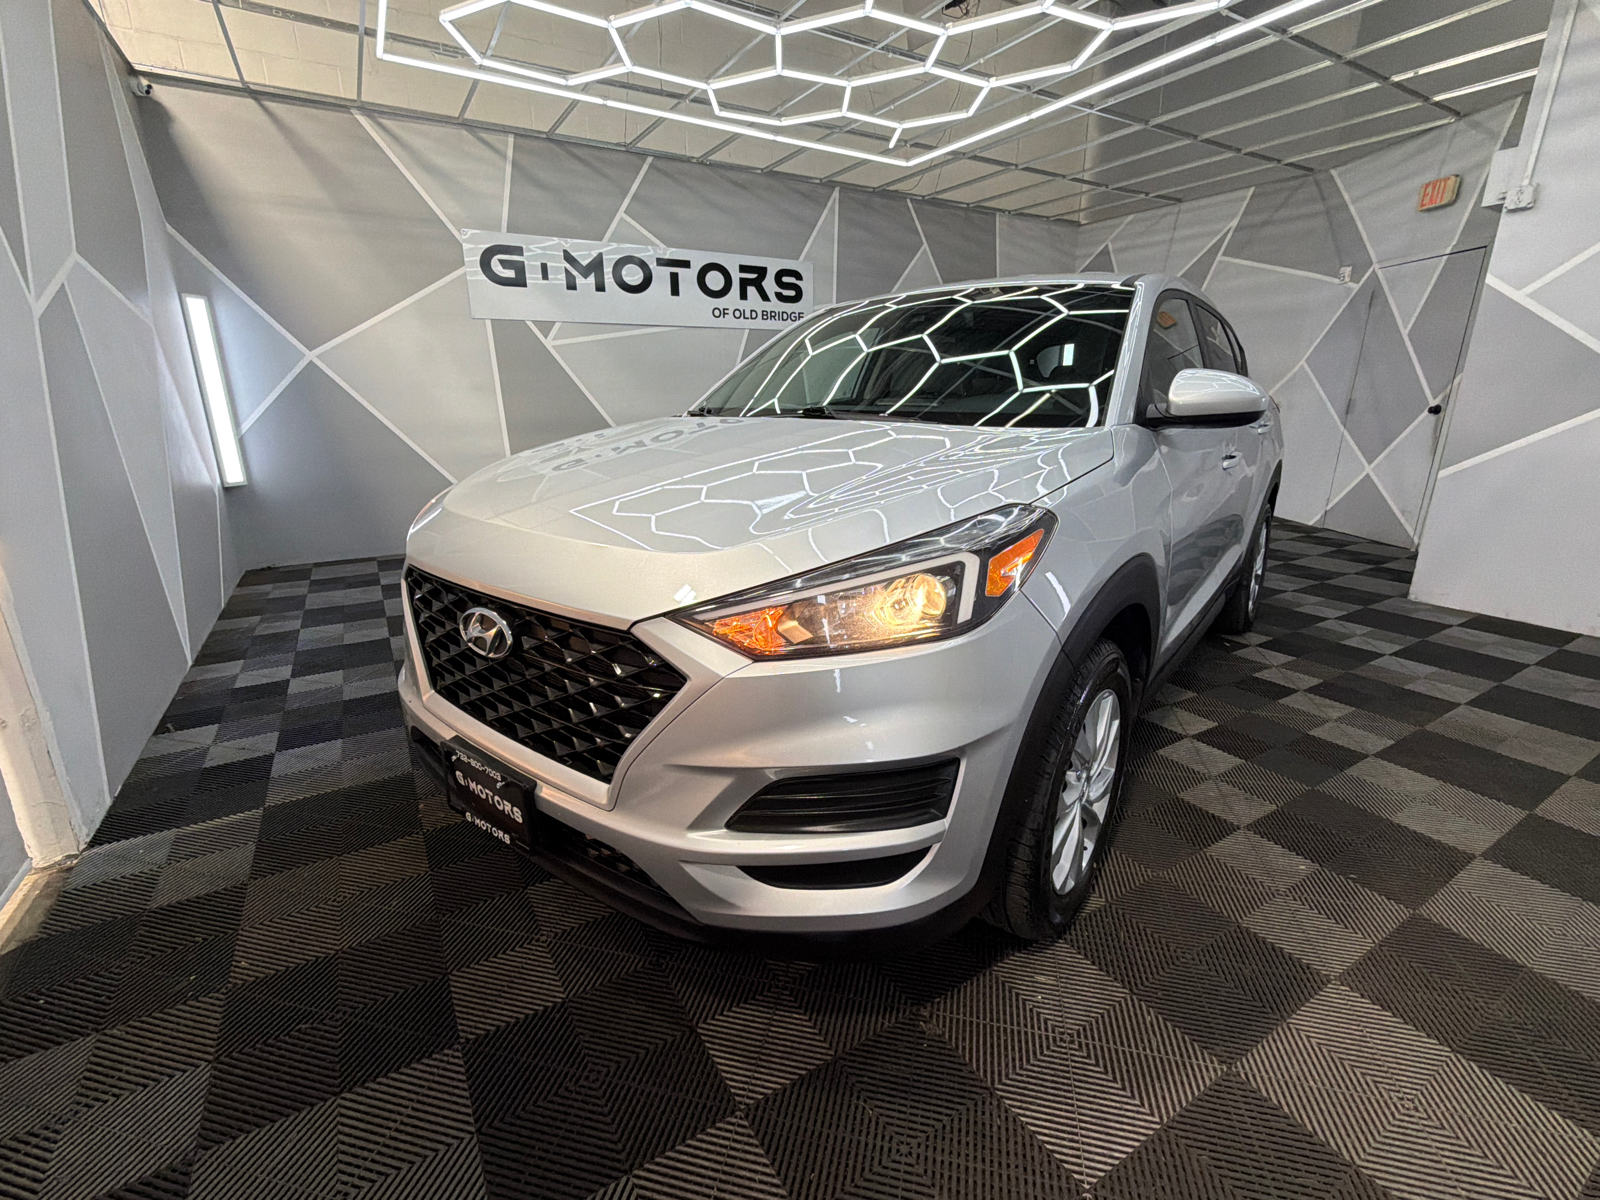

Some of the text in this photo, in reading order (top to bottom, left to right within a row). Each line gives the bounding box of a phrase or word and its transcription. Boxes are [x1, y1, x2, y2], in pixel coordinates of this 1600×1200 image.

[1420, 177, 1450, 207] EXIT
[712, 307, 804, 322] OF OLD BRIDGE
